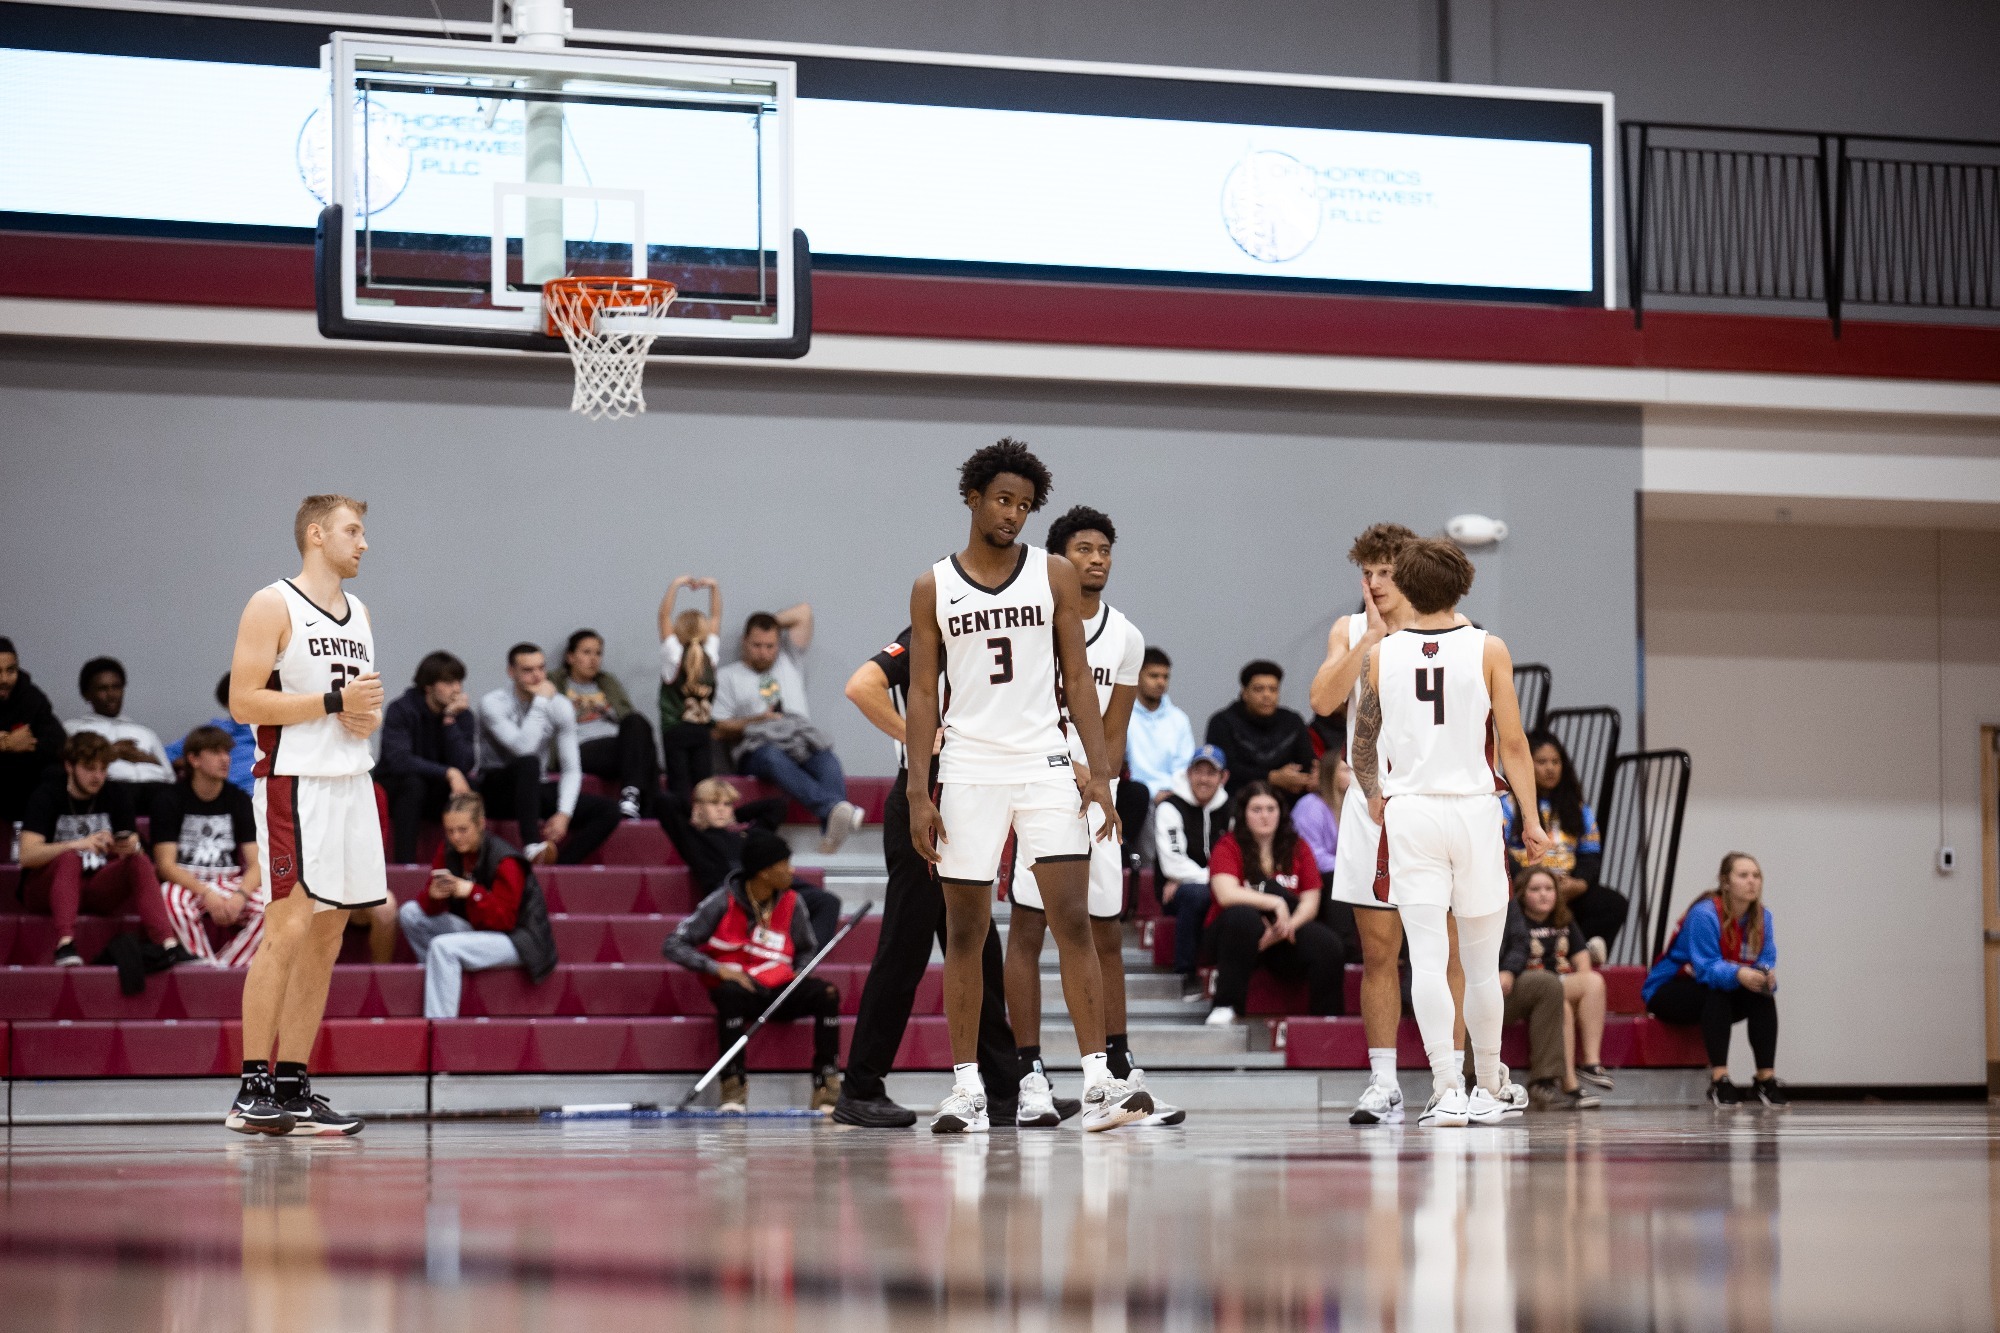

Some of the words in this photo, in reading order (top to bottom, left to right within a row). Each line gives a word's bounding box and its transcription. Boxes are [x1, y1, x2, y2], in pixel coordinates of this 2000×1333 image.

[384, 134, 523, 156] NORTHWES
[420, 157, 480, 176] PLLC
[1329, 207, 1385, 225] PLLC
[948, 605, 1045, 637] CENTRAL
[308, 637, 370, 663] CENTRAL
[986, 636, 1014, 685] 3
[1415, 666, 1445, 726] 4
